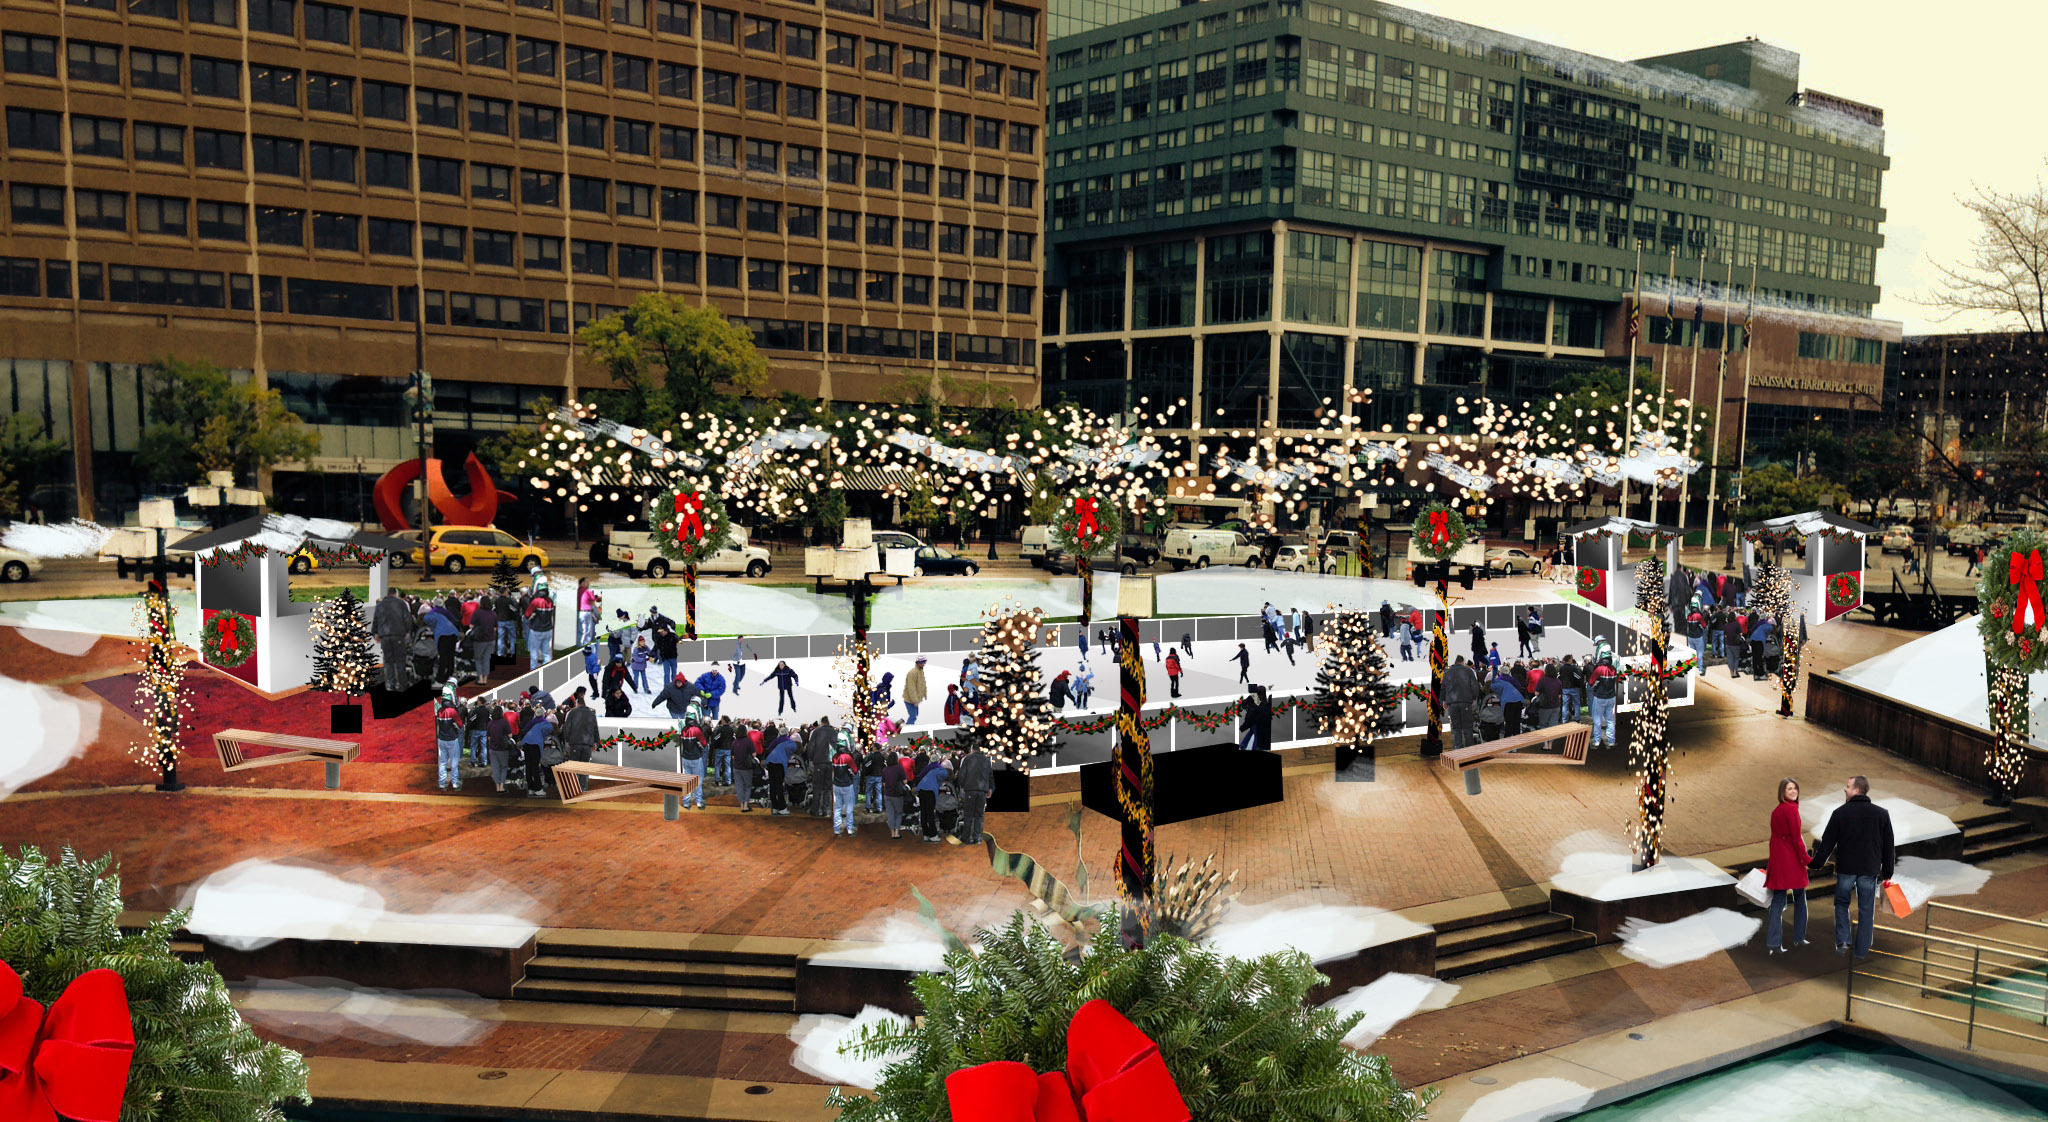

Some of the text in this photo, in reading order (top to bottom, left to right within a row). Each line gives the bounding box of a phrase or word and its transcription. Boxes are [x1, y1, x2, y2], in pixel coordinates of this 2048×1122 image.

[1749, 375, 1876, 394] RENAISSANCE HARBORPLACE HOTEL
